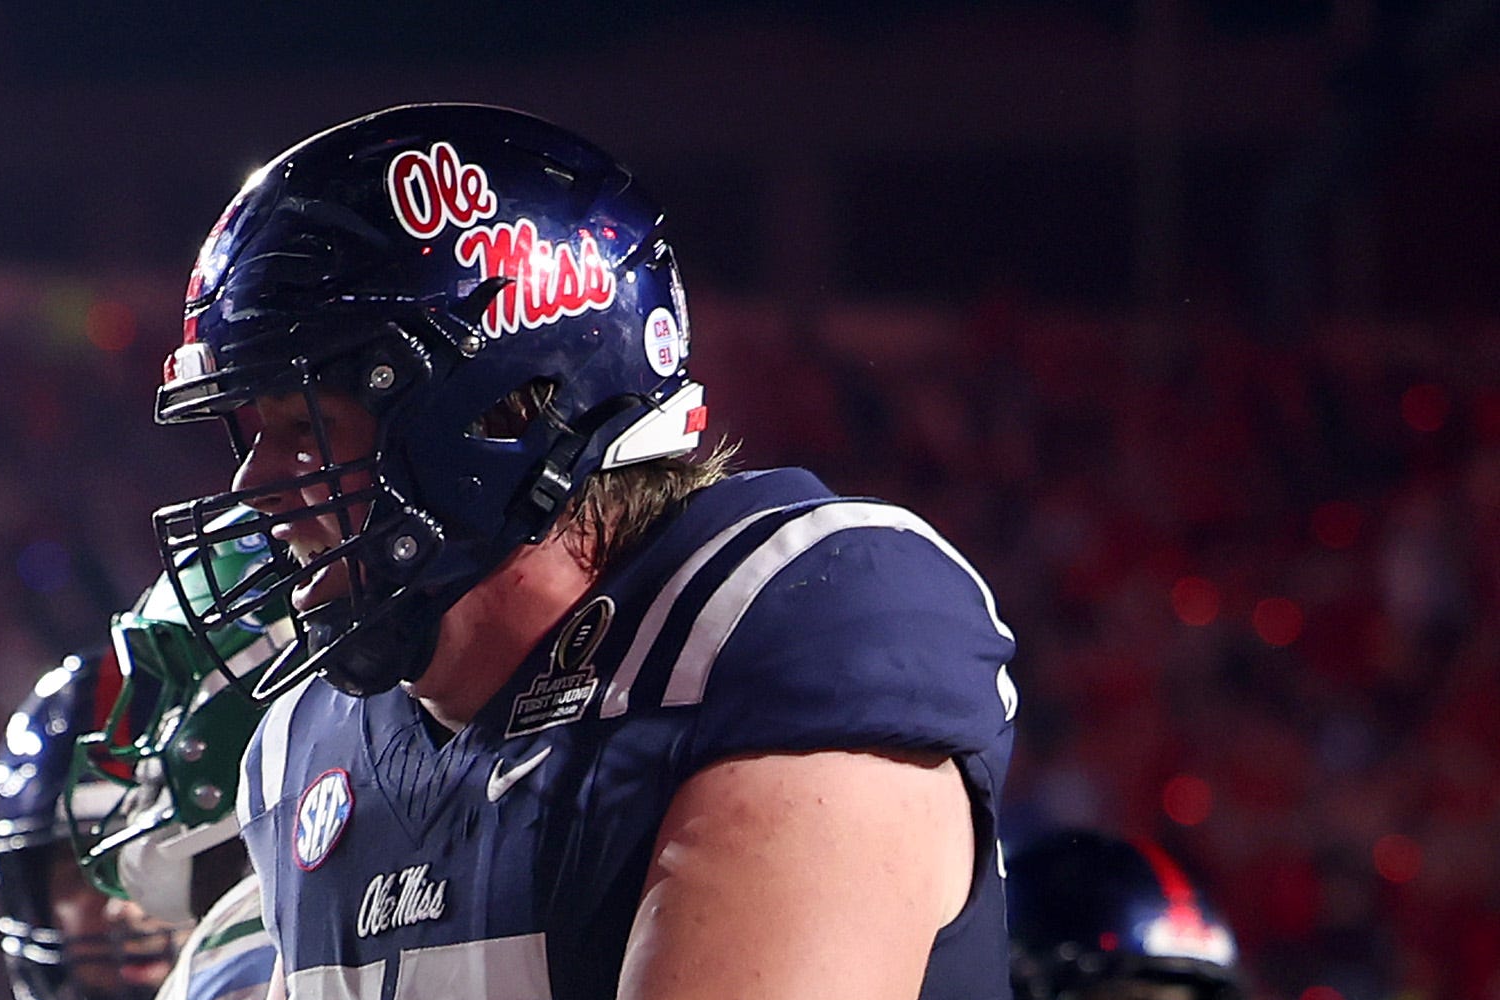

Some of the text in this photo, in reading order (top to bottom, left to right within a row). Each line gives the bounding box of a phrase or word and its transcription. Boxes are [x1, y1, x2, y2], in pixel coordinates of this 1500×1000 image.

[388, 141, 498, 239] Ole
[455, 218, 616, 338] Miss
[298, 773, 349, 862] SEC
[357, 863, 447, 938] Ole Miss
